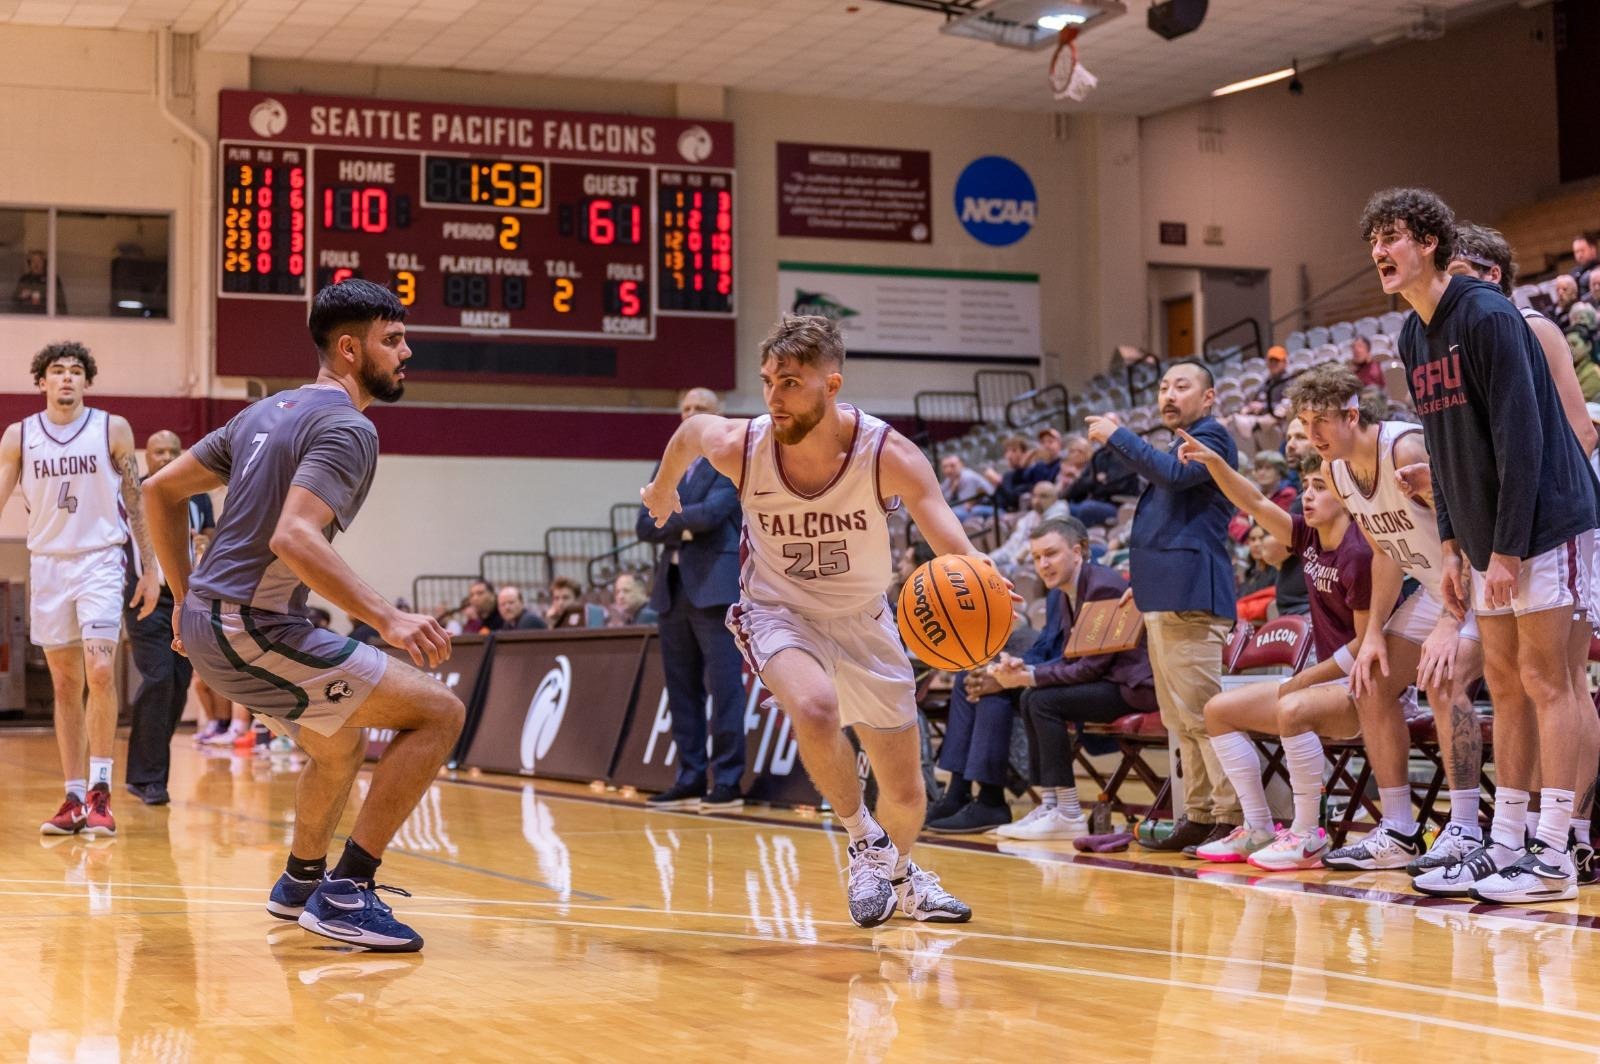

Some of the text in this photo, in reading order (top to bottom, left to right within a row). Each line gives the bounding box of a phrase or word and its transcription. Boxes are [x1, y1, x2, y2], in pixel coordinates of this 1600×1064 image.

[311, 106, 656, 155] SEATTLE PACIFIC FALCONS
[240, 165, 253, 186] 3
[264, 168, 272, 186] 1
[339, 160, 395, 183] HOME
[232, 187, 252, 206] 11
[258, 187, 272, 208] 0
[470, 163, 543, 208] 1:53
[583, 174, 639, 197] GUEST
[675, 191, 684, 208] 1
[693, 191, 702, 209] 1
[962, 196, 1037, 227] NCAA
[225, 208, 304, 232] 22 0 3
[588, 199, 641, 246] 61
[664, 210, 684, 228] 11
[225, 229, 304, 253] 23 0 3
[443, 222, 495, 241] PERIOD
[499, 215, 521, 251] 2
[225, 251, 304, 276] 25 0 0
[320, 250, 360, 268] FOULS
[386, 252, 425, 271] T.O.L.
[440, 256, 532, 276] PLAYER FOUL
[545, 260, 582, 279] T.O.L.
[694, 252, 702, 270] 1
[607, 264, 644, 282] FOULS
[396, 271, 417, 306] 3
[553, 278, 574, 314] 2
[619, 279, 641, 317] 5
[461, 311, 510, 329] MATCH
[603, 317, 647, 334] SCORE
[1412, 353, 1462, 400] SPU
[34, 455, 97, 479] FALCONS
[241, 432, 268, 481] 7
[57, 482, 78, 514] 4
[758, 509, 867, 538] FALCONS
[783, 538, 850, 580] 25
[1377, 538, 1432, 569] 24
[946, 571, 976, 611] EVO
[913, 572, 947, 647] Wilson
[1256, 628, 1298, 648] FALCONS
